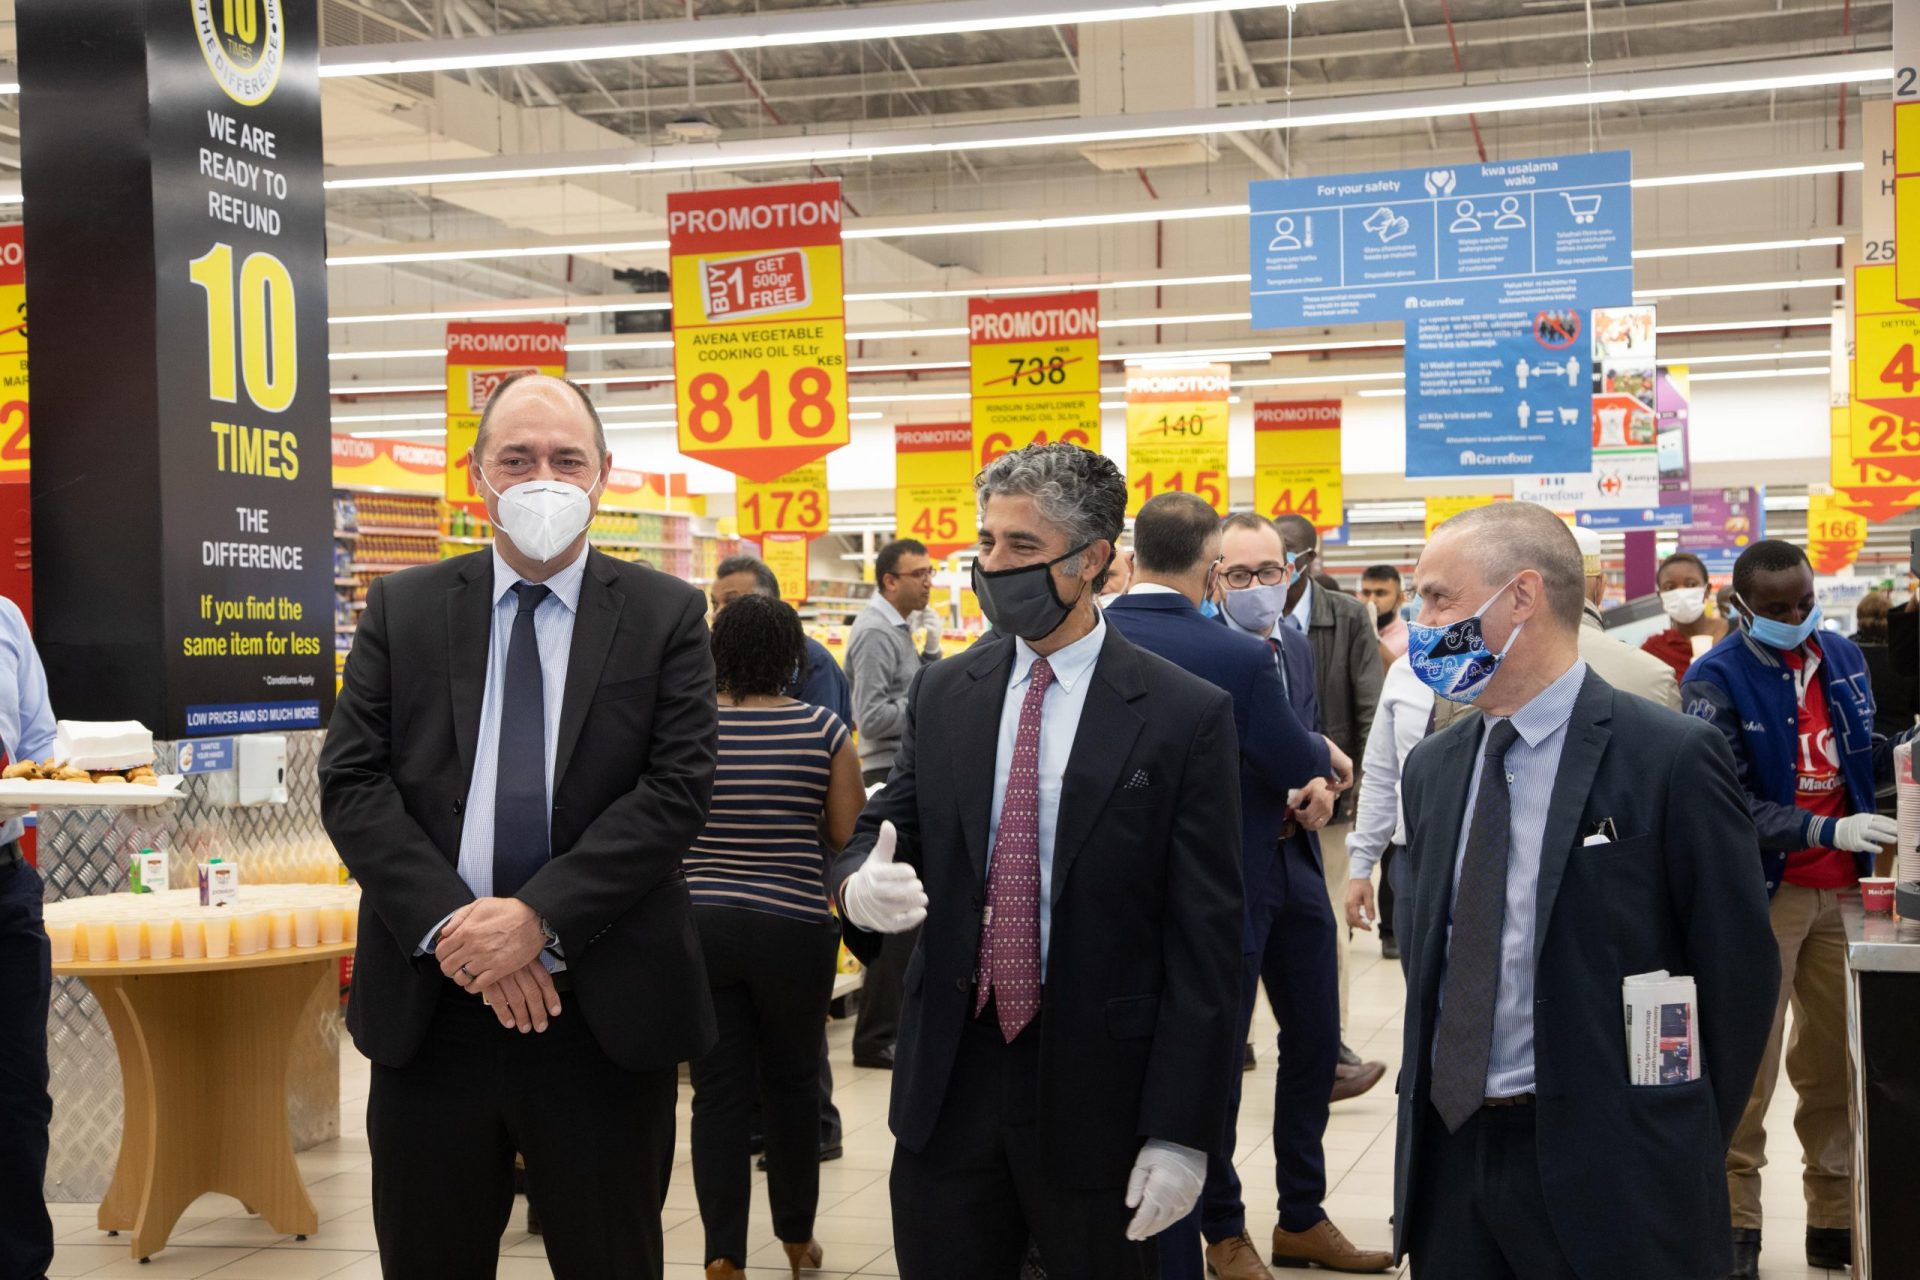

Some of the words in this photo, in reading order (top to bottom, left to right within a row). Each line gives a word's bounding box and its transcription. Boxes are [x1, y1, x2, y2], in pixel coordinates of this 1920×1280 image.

[215, 36, 278, 95] DIFFERENCE
[207, 110, 236, 144] WE
[240, 124, 276, 159] ARE
[200, 148, 260, 195] READY
[263, 169, 287, 200] TO
[1481, 166, 1505, 178] kwa
[1507, 162, 1558, 175] usalama
[1504, 175, 1536, 187] wako
[1317, 185, 1335, 197] For
[1337, 184, 1363, 197] your
[1365, 180, 1400, 193] safety
[208, 191, 281, 236] REFUND
[669, 200, 841, 235] PROMOTION
[755, 257, 786, 273] GET
[708, 267, 730, 314] BUY
[727, 267, 745, 305] 1
[752, 273, 794, 289] 500gr
[750, 287, 798, 308] FREE
[1420, 297, 1464, 308] Carrefour
[189, 242, 297, 413] 10
[969, 307, 1097, 340] PROMOTION
[447, 334, 565, 352] PROMOTION
[693, 332, 738, 347] AVENA
[742, 327, 824, 343] VEGETABLE
[698, 347, 763, 362] COOKING
[766, 345, 789, 358] OIL
[793, 343, 820, 357] 5Ltr
[817, 355, 842, 366] KES
[1008, 356, 1066, 387] 738
[1127, 375, 1230, 394] PROMOTION
[688, 366, 836, 443] 818
[1025, 400, 1086, 411] SUNFLOWER
[1254, 406, 1341, 423] PROMOTION
[991, 413, 1036, 424] COOKING
[1038, 412, 1054, 422] OIL
[1158, 414, 1203, 437] 140
[211, 421, 299, 481] TIMES
[393, 444, 446, 468] PROMOTIO
[1476, 452, 1534, 466] Carrefour
[743, 490, 822, 530] 173
[1271, 487, 1322, 521] 44
[236, 507, 269, 534] THE
[911, 507, 958, 540] 45
[1817, 521, 1857, 539] 166
[202, 541, 303, 571] DIFFERENCE
[201, 594, 213, 619] If
[215, 601, 243, 625] you
[246, 596, 275, 620] find
[278, 597, 302, 620] the
[183, 637, 227, 656] same
[230, 632, 263, 656] item
[265, 632, 287, 655] for
[290, 631, 320, 655] less
[187, 712, 207, 727] LOW
[208, 709, 238, 725] PRICES
[239, 709, 256, 723] AND
[257, 709, 268, 722] SO
[269, 707, 293, 721] MUCH
[294, 706, 319, 719] MORE!
